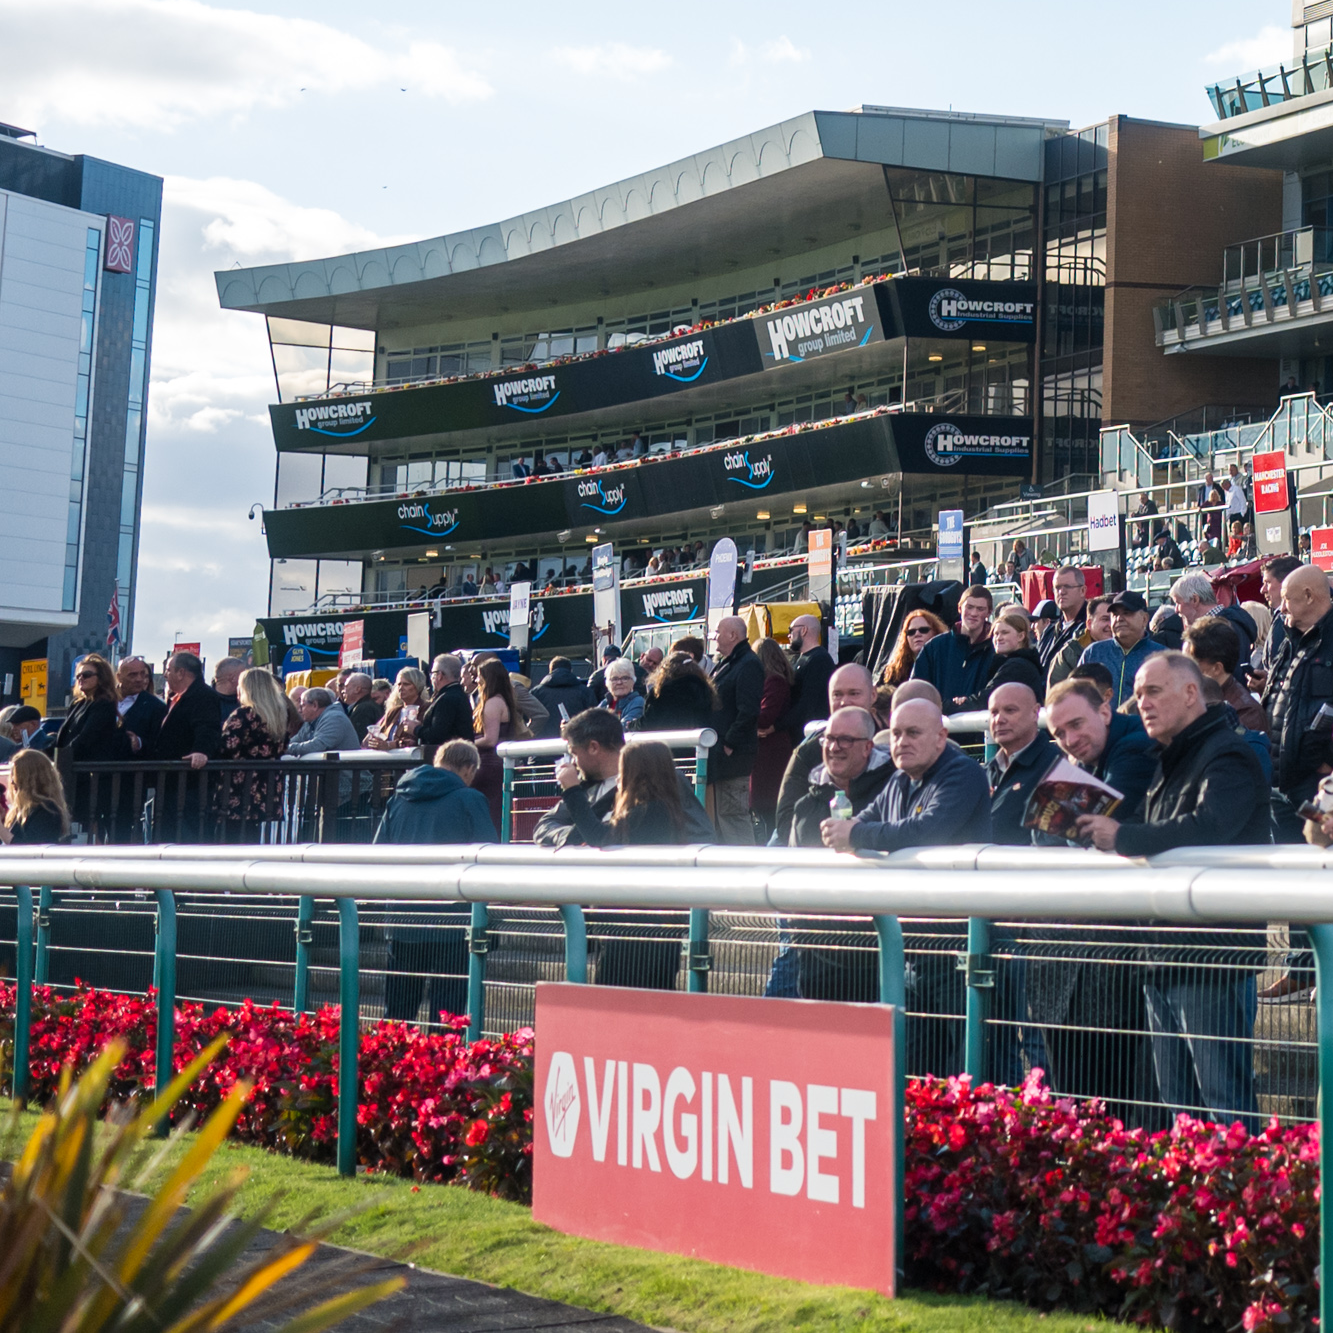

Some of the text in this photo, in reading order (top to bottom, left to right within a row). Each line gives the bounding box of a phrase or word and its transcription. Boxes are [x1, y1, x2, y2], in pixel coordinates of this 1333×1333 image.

[941, 299, 1034, 317] HOWCROFT
[957, 311, 1033, 321] Industrial Supplies
[767, 296, 865, 361] HOWCROFT
[798, 328, 857, 357] group limited
[652, 339, 704, 376] HOWCROFT
[668, 356, 700, 373] group limited
[493, 375, 556, 406] HOWCROFT
[512, 390, 550, 404] group limited
[295, 401, 372, 429] HOWCROFT
[317, 415, 364, 429] group limited
[937, 434, 1030, 452] HOWCROFT
[953, 445, 1030, 455] Industrial Supplies
[1254, 468, 1285, 482] MANCHESTER
[1261, 482, 1279, 495] RACING
[1090, 512, 1117, 530] Hadbet
[714, 552, 733, 564] PHOENIX
[642, 588, 694, 617] HOWCROFT
[658, 603, 690, 617] group limited
[283, 621, 344, 645] HOWCRO
[326, 635, 343, 644] limit
[583, 1055, 877, 1209] VIRGIN BET
